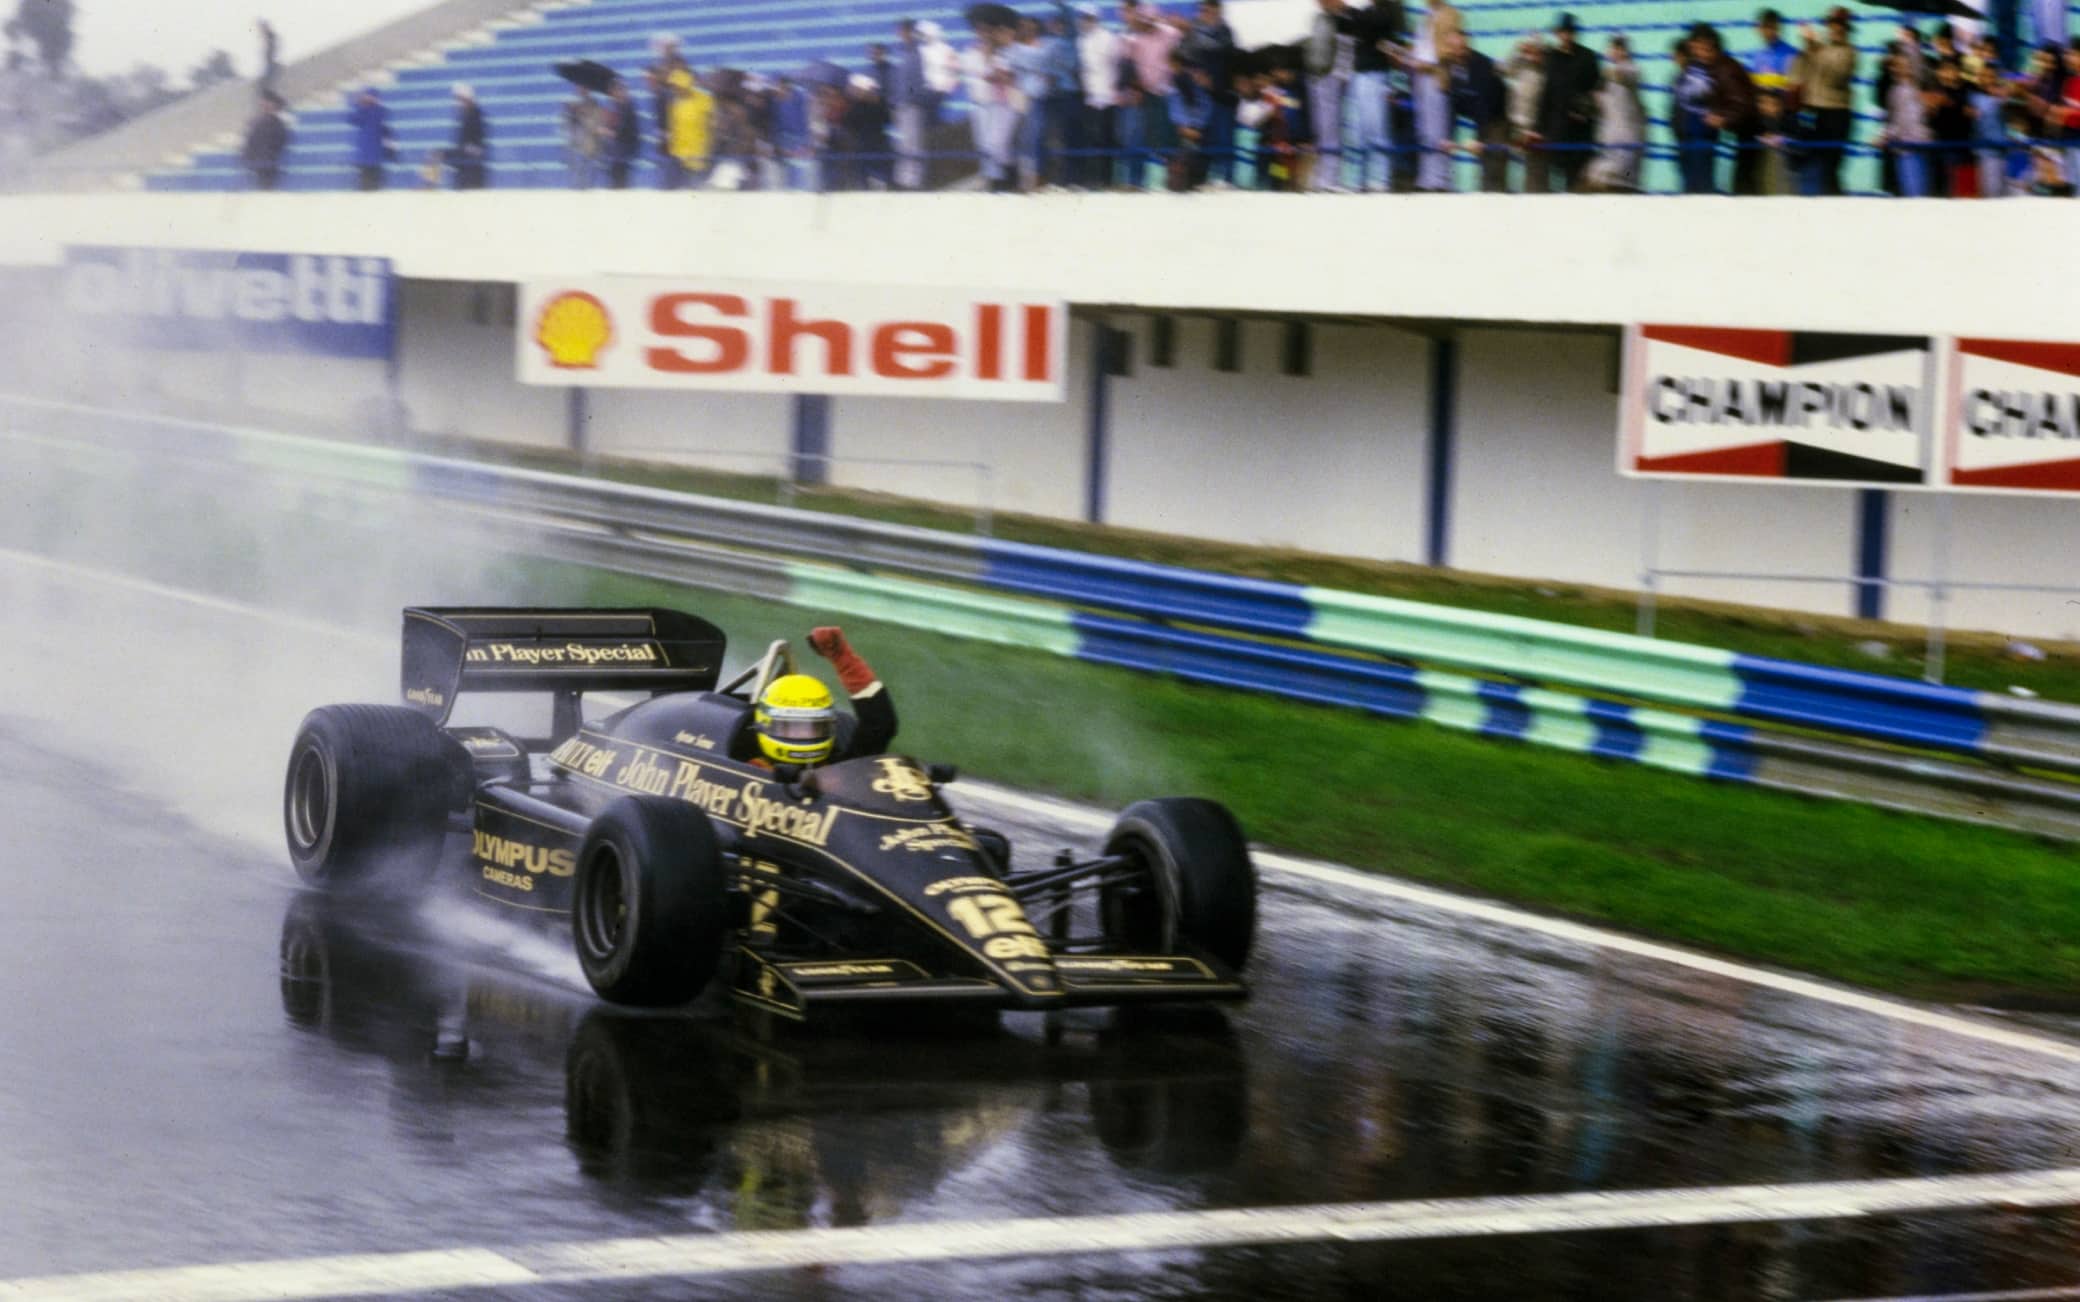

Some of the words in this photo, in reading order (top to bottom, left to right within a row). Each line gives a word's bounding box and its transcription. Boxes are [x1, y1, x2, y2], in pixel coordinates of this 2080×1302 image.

[642, 290, 1053, 383] Shell
[1645, 374, 1919, 432] CHAMPION
[1961, 388, 2080, 440] CHA
[489, 644, 565, 664] Player
[565, 643, 656, 664] Special
[615, 748, 671, 796] John
[669, 760, 739, 816] Player
[734, 781, 838, 846] Special
[482, 865, 533, 891] CAMERAS
[946, 894, 1037, 939] 12
